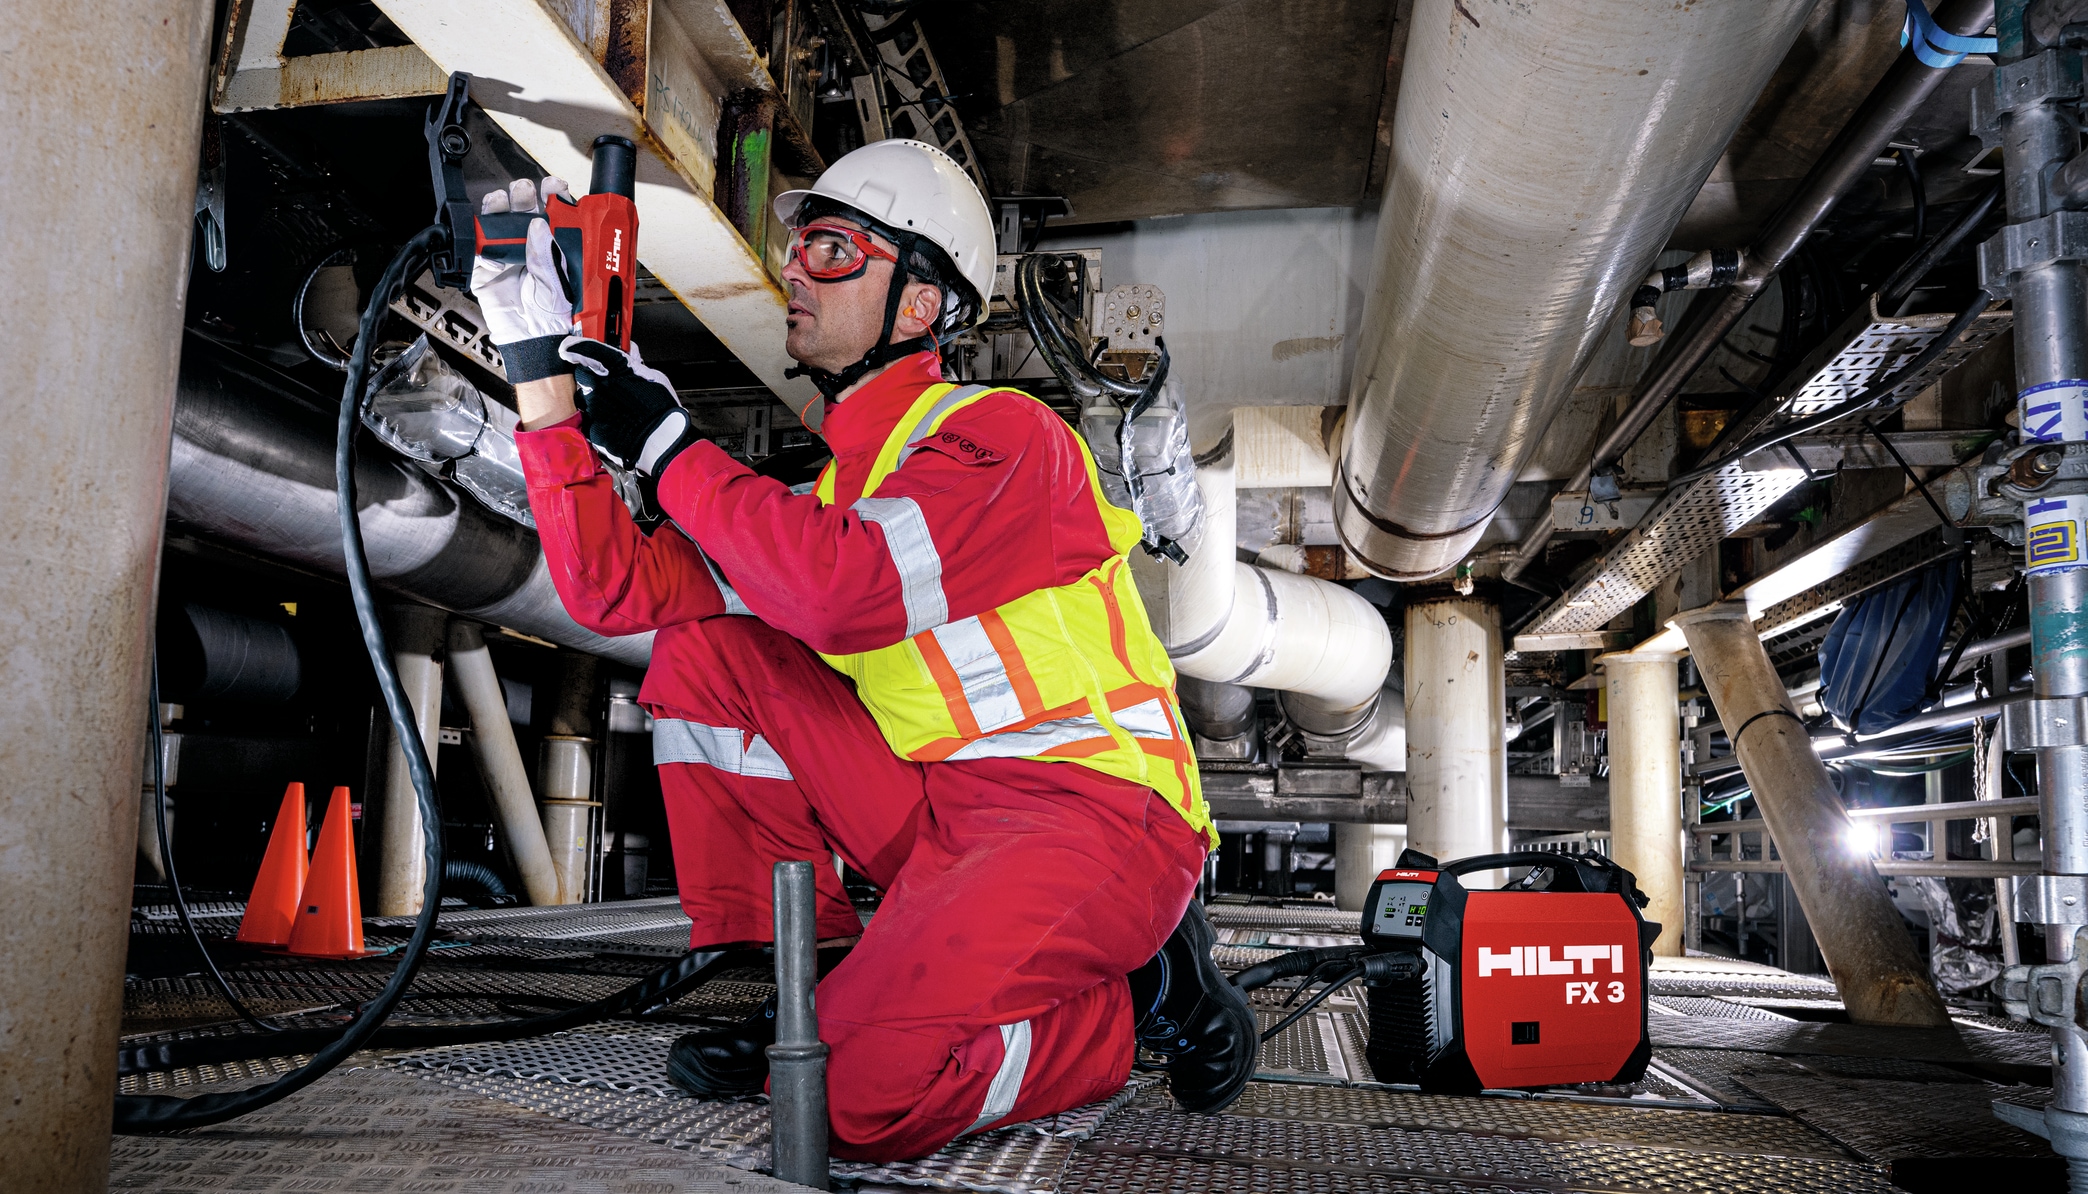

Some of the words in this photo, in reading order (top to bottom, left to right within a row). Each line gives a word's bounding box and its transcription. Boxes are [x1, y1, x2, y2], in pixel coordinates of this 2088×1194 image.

[606, 251, 613, 262] FX
[613, 228, 622, 273] HILTI
[1478, 945, 1624, 977] HILTI
[1566, 982, 1600, 1004] FX
[1607, 981, 1625, 1003] 3
